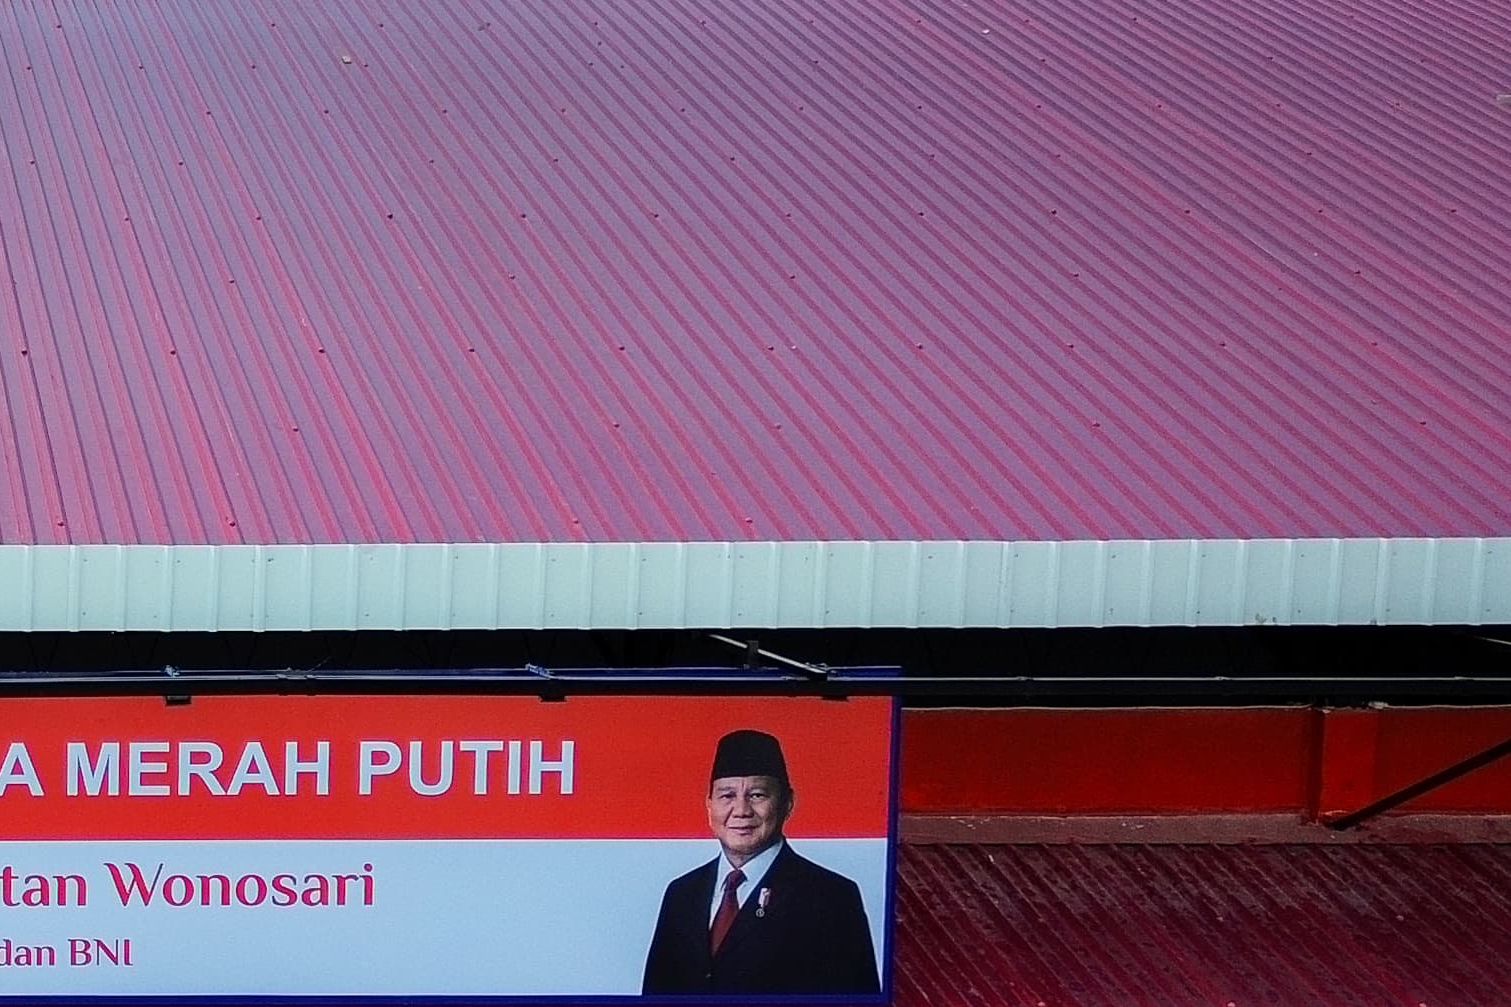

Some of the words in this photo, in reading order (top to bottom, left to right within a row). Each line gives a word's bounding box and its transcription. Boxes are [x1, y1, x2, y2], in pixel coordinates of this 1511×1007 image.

[65, 740, 330, 797] MERAH
[358, 739, 576, 796] PUTIH
[103, 861, 375, 907] Wonosari
[67, 938, 134, 967] BNI
